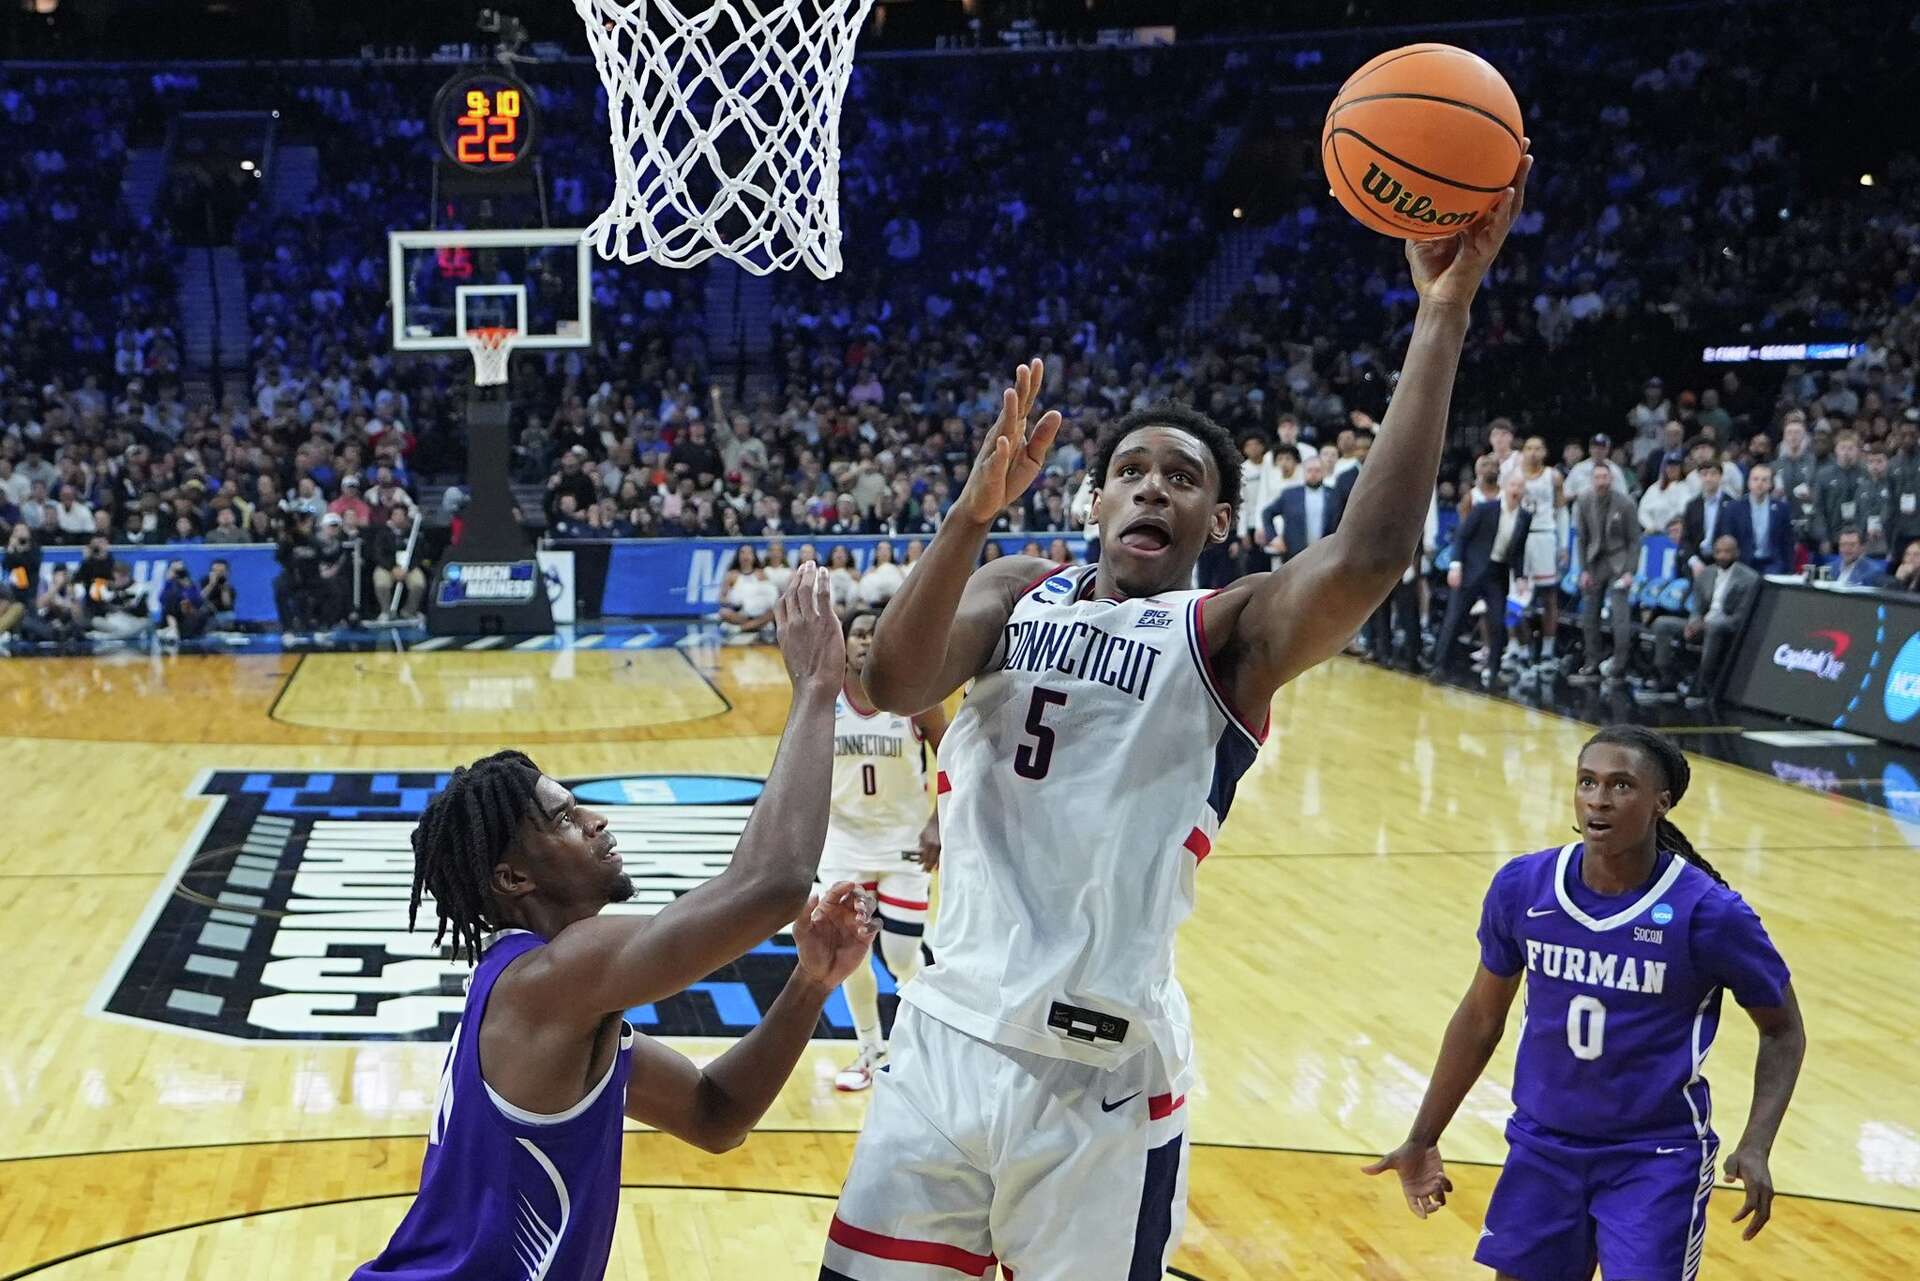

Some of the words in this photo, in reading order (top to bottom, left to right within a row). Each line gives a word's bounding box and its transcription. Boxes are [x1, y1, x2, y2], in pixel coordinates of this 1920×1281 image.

[467, 90, 520, 117] 9:10
[457, 116, 516, 162] 22
[1361, 161, 1479, 226] Wilson
[1137, 617, 1173, 627] EAST
[1143, 609, 1170, 619] BIG
[999, 620, 1161, 701] CONNCTICUT
[1013, 686, 1068, 781] 5
[862, 765, 877, 796] 0
[1526, 939, 1667, 994] FURMAN
[1566, 993, 1607, 1061] 0
